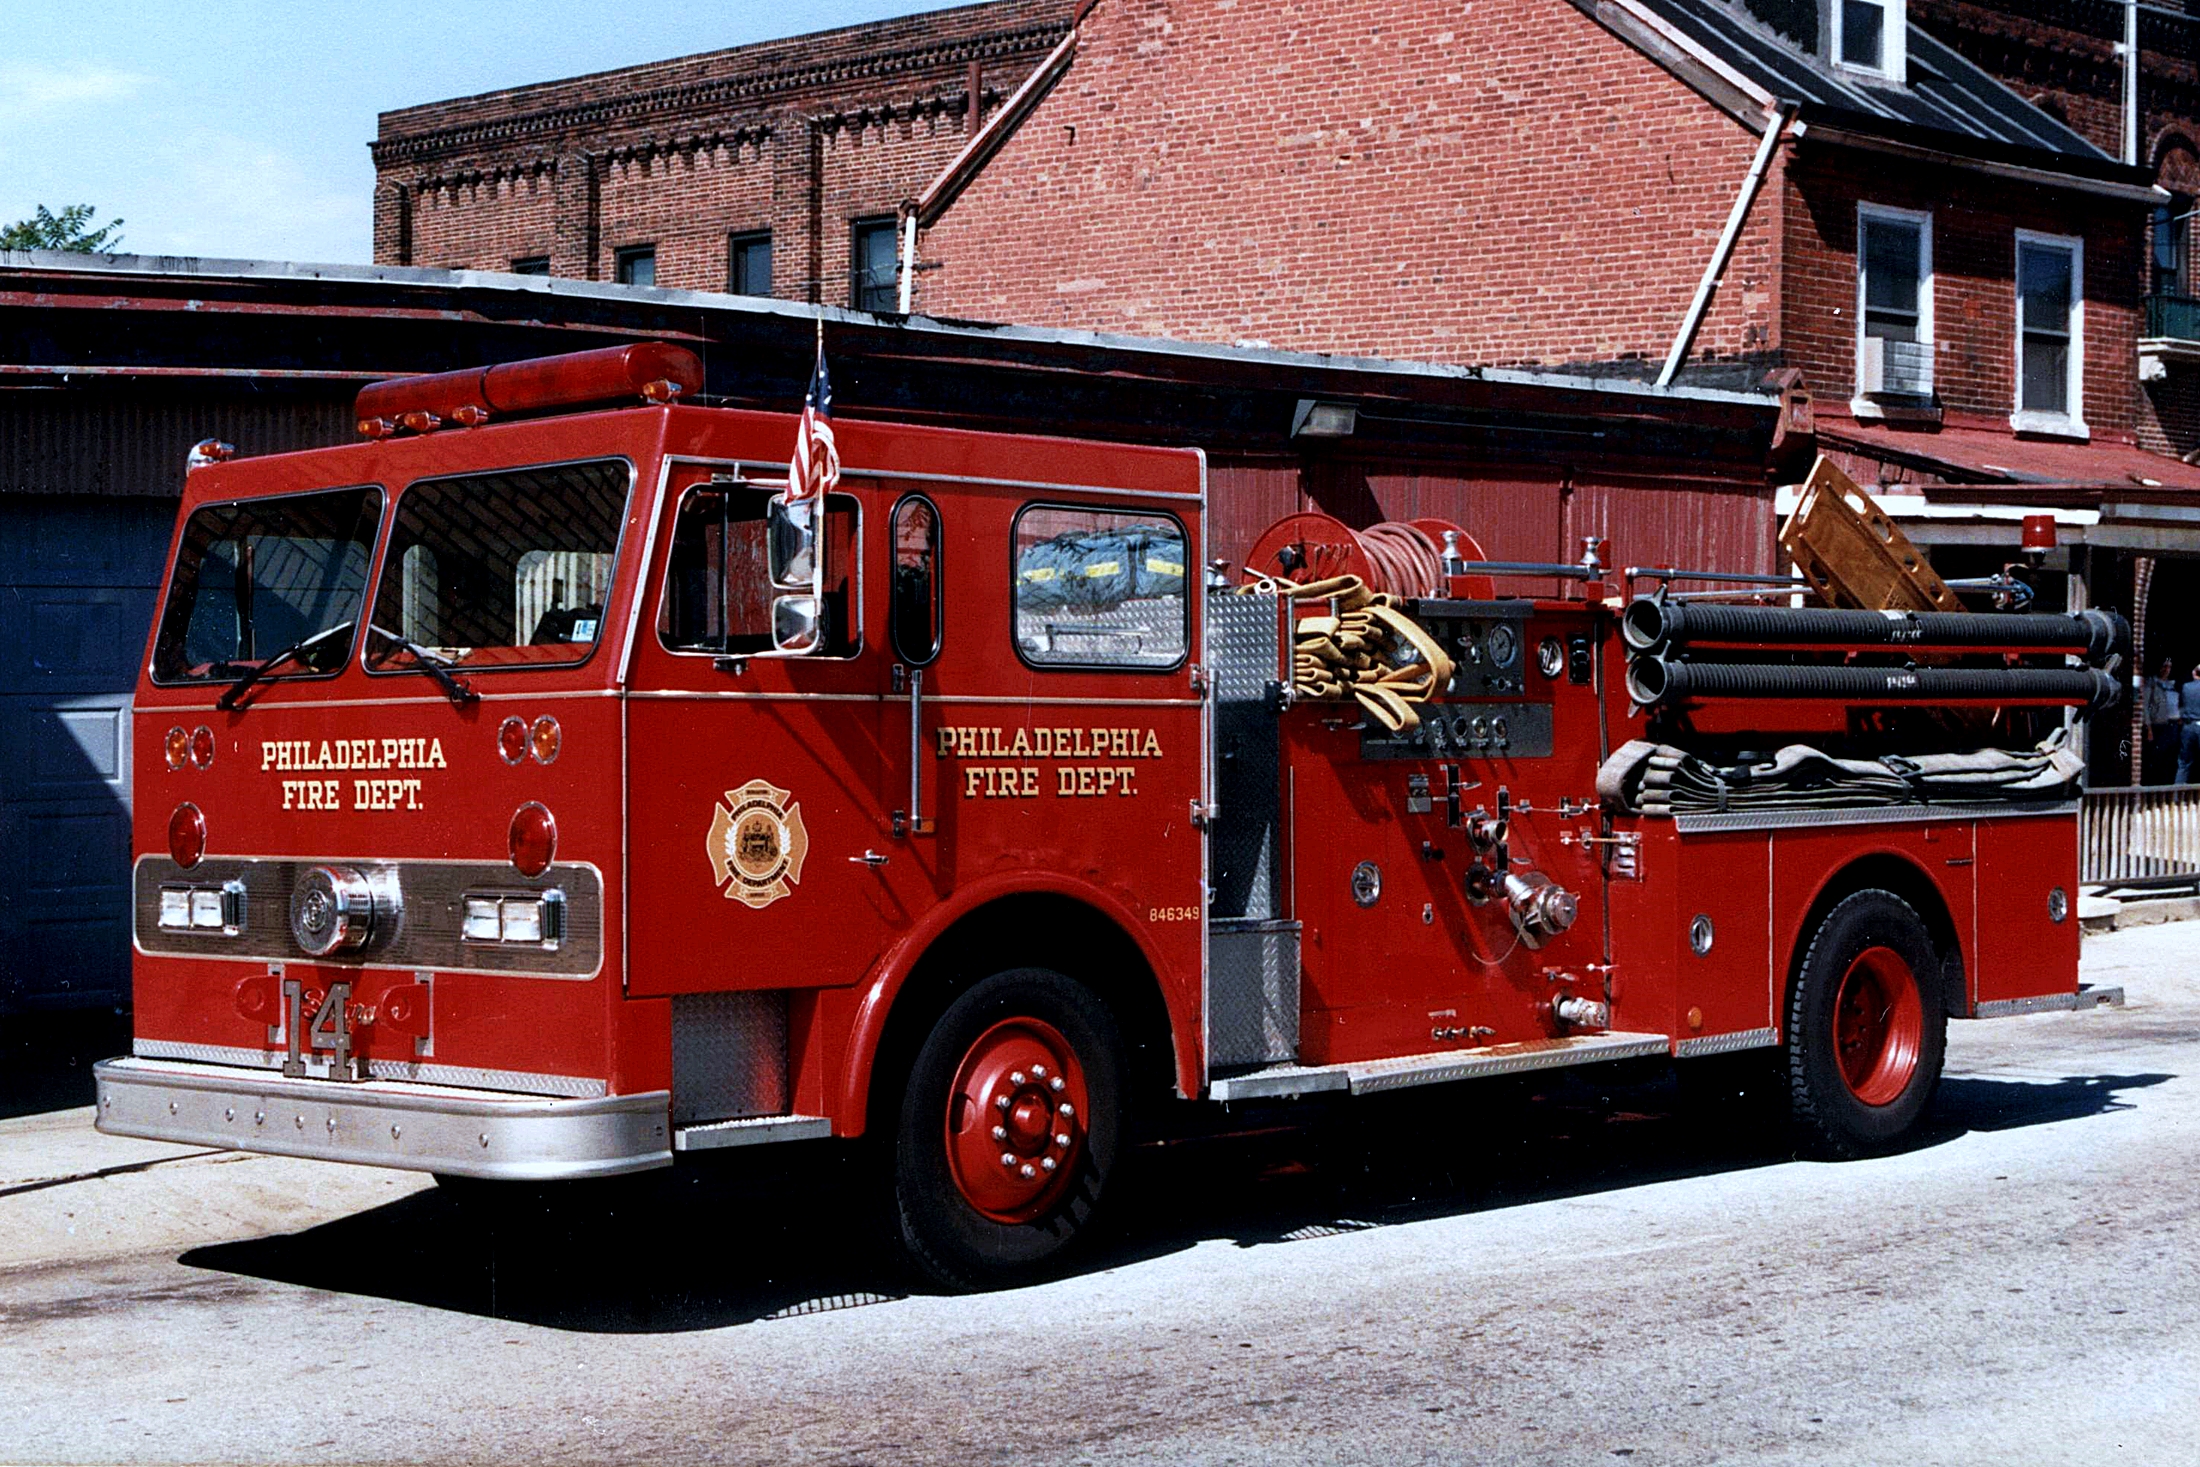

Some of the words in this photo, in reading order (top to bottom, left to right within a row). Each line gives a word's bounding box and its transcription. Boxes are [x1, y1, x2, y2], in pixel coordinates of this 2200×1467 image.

[261, 738, 447, 770] PHILADELPHIA
[936, 727, 1163, 757] PHILADELPHIA
[282, 780, 340, 810] FIRE
[354, 779, 423, 810] DEPT.
[965, 767, 1039, 796] FIRE
[1057, 767, 1138, 796] DEPT.
[730, 800, 784, 820] PHILADELPHIA
[726, 860, 741, 879] FIRE
[742, 859, 788, 887] DEPARTMENT
[1150, 906, 1200, 922] 846349
[283, 979, 352, 1082] 14
